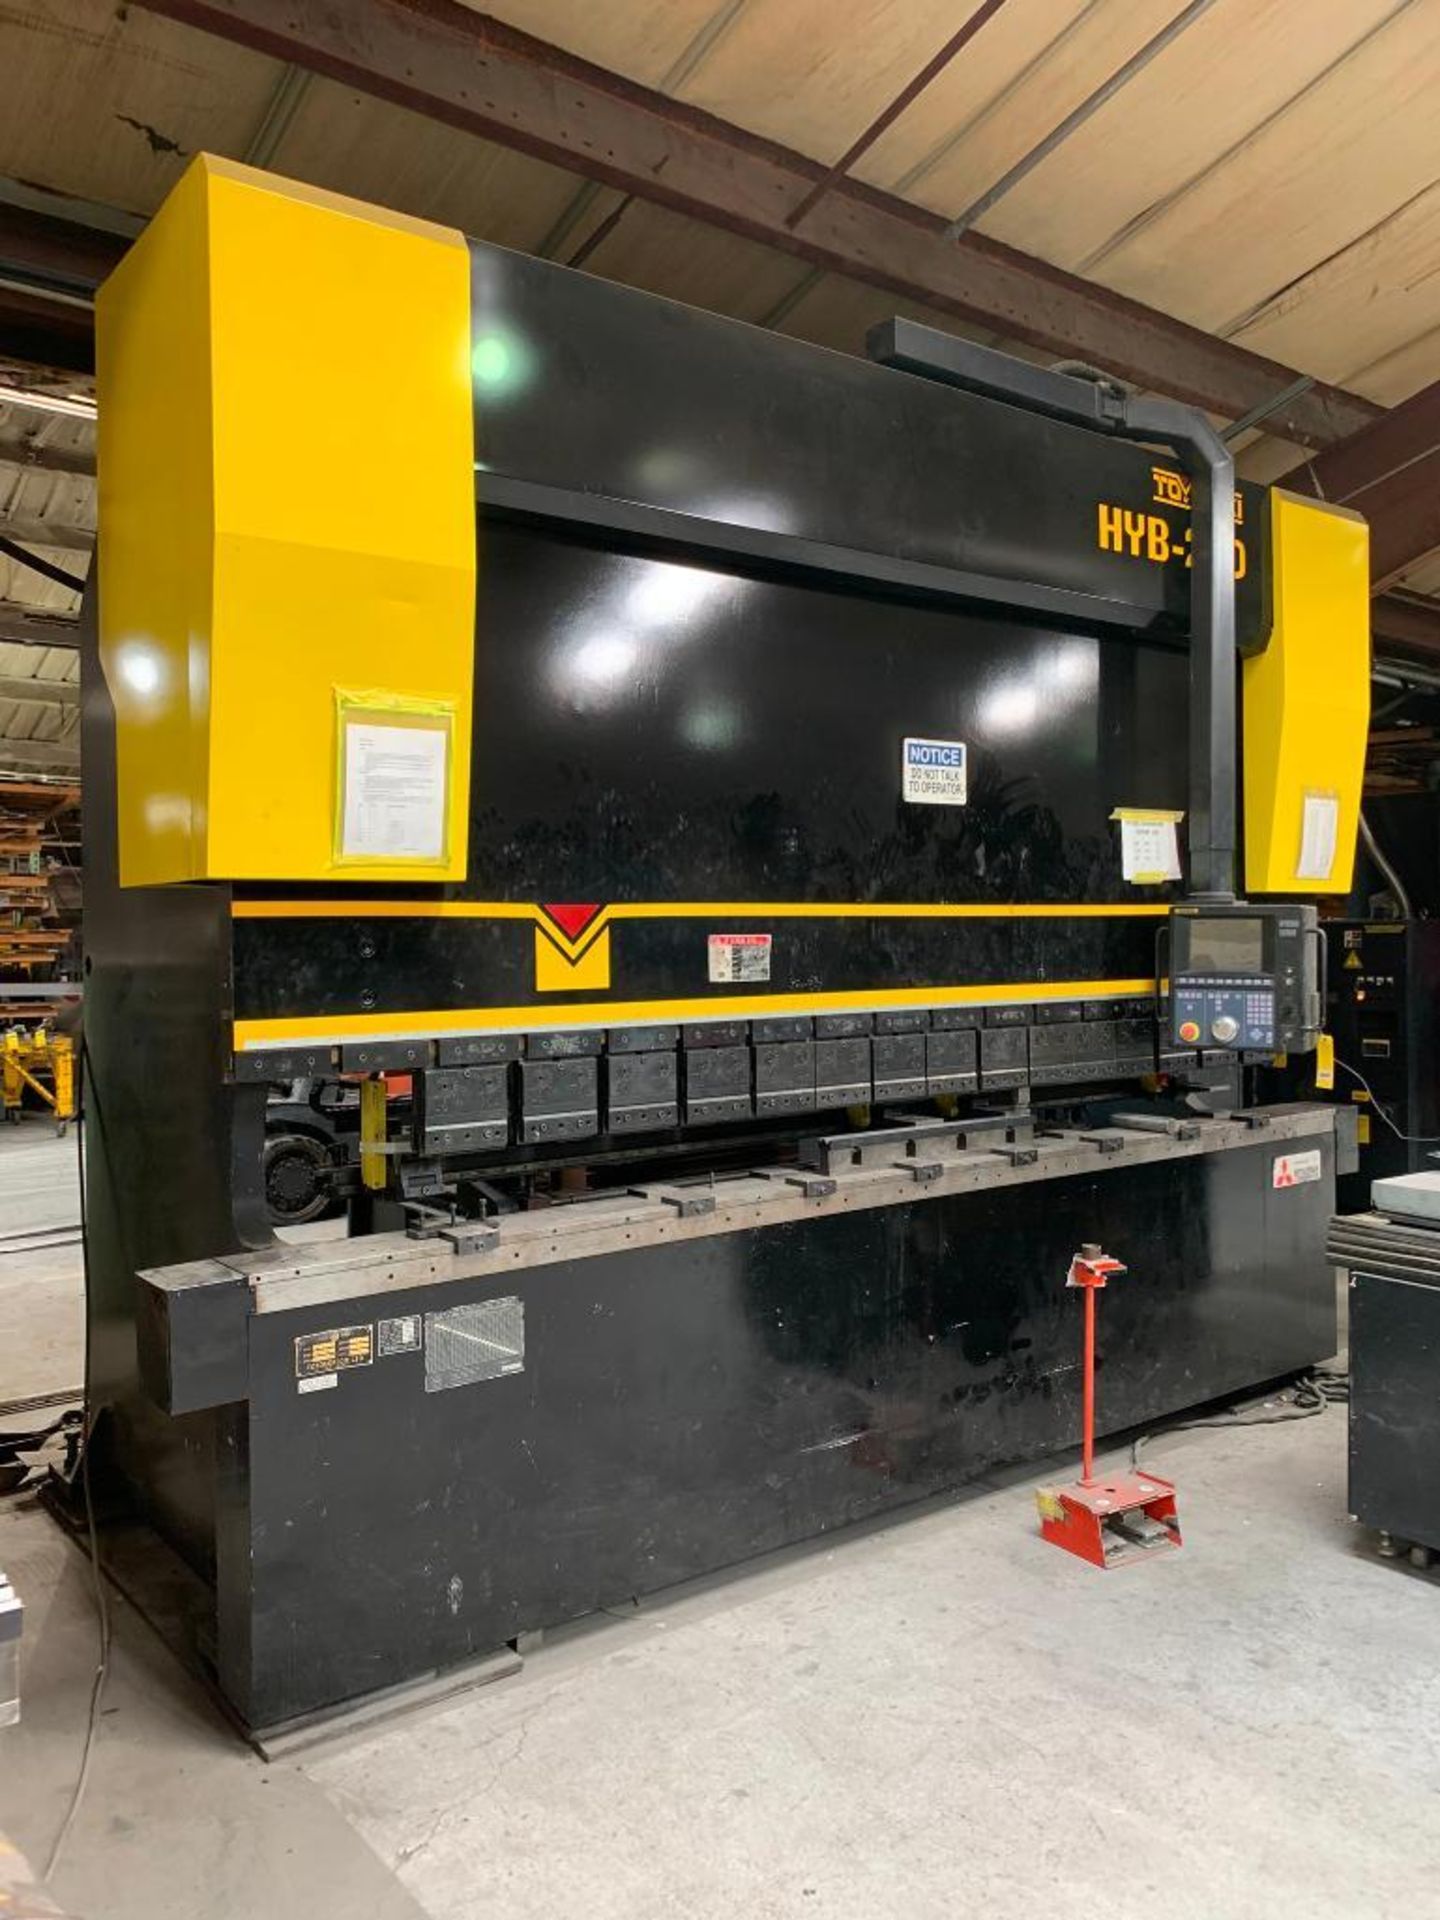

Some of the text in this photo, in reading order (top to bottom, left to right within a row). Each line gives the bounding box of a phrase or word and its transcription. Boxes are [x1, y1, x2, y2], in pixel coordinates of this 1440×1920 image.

[911, 746, 959, 765] NOTICE
[911, 767, 959, 781] DO NOT TALK
[908, 780, 920, 793] TO
